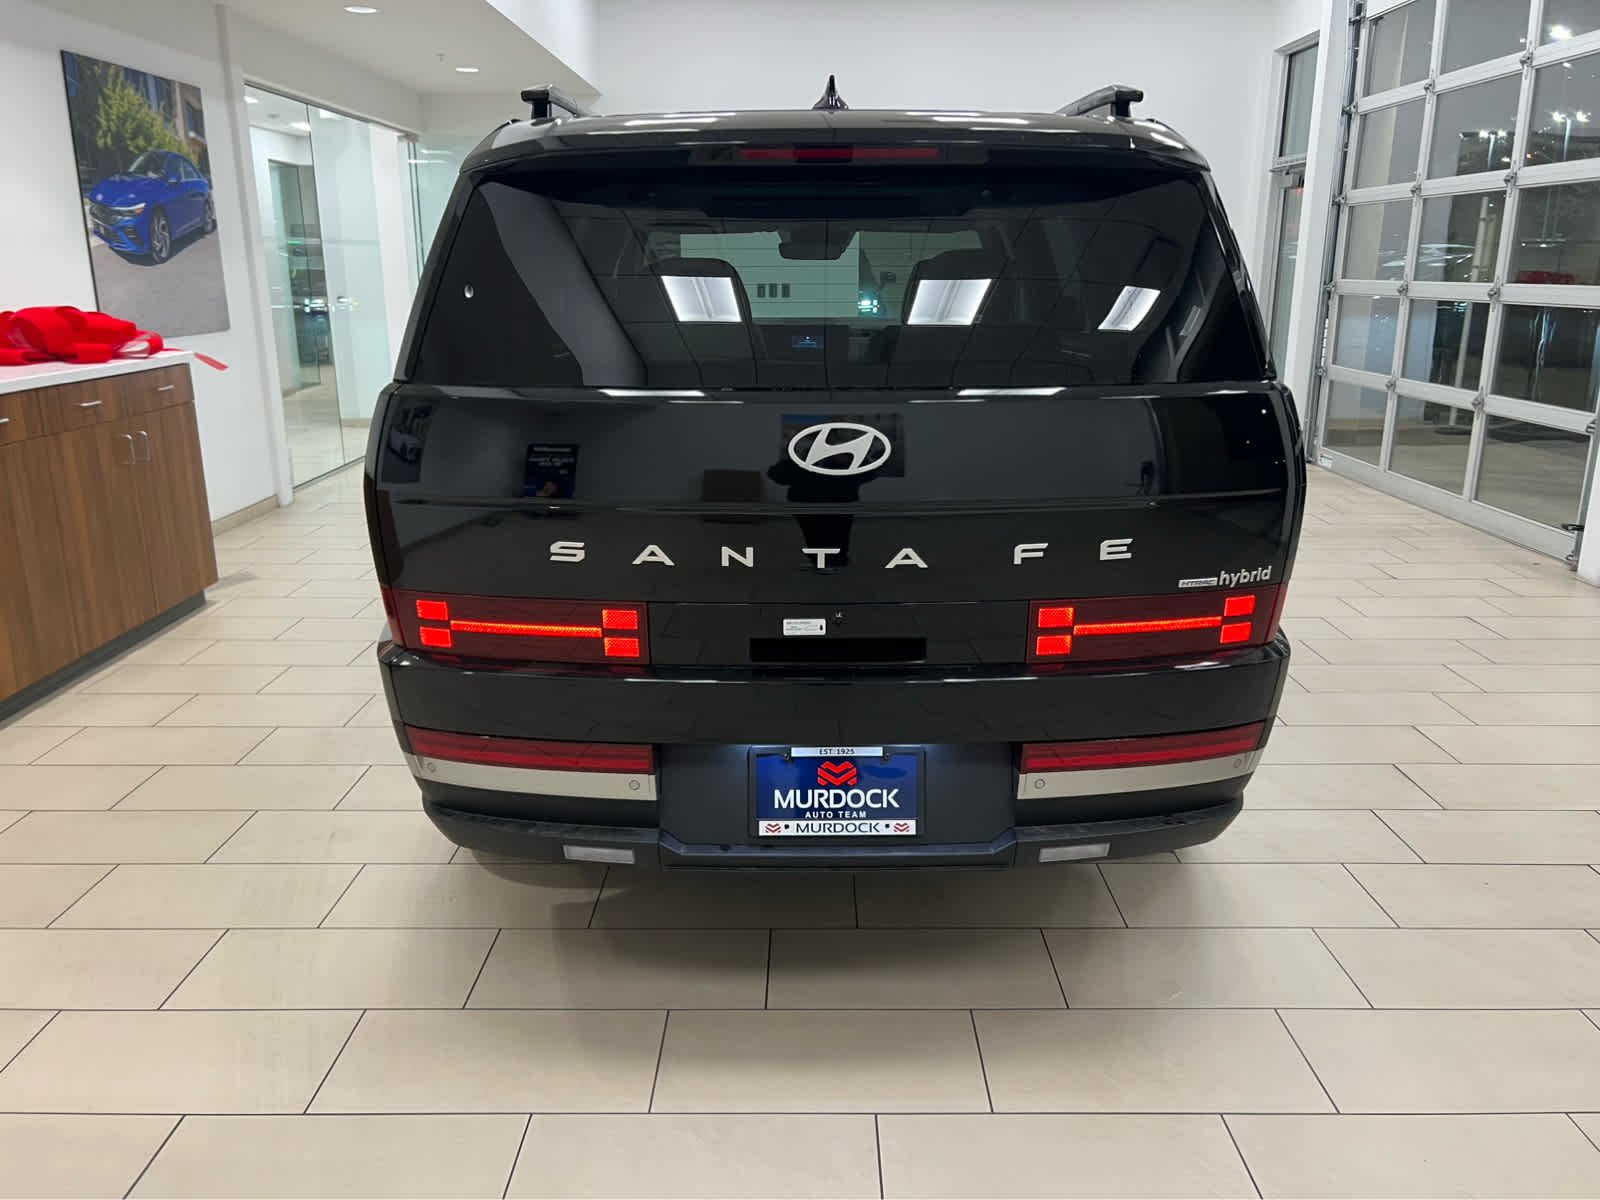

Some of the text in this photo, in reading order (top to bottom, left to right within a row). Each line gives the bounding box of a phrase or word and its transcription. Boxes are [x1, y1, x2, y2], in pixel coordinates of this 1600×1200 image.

[549, 538, 1134, 569] SANTA FE
[1219, 566, 1273, 588] hybrid
[774, 788, 900, 809] MURDOCK
[804, 811, 867, 819] AUTO TEAM
[796, 822, 880, 834] MURDOCK
